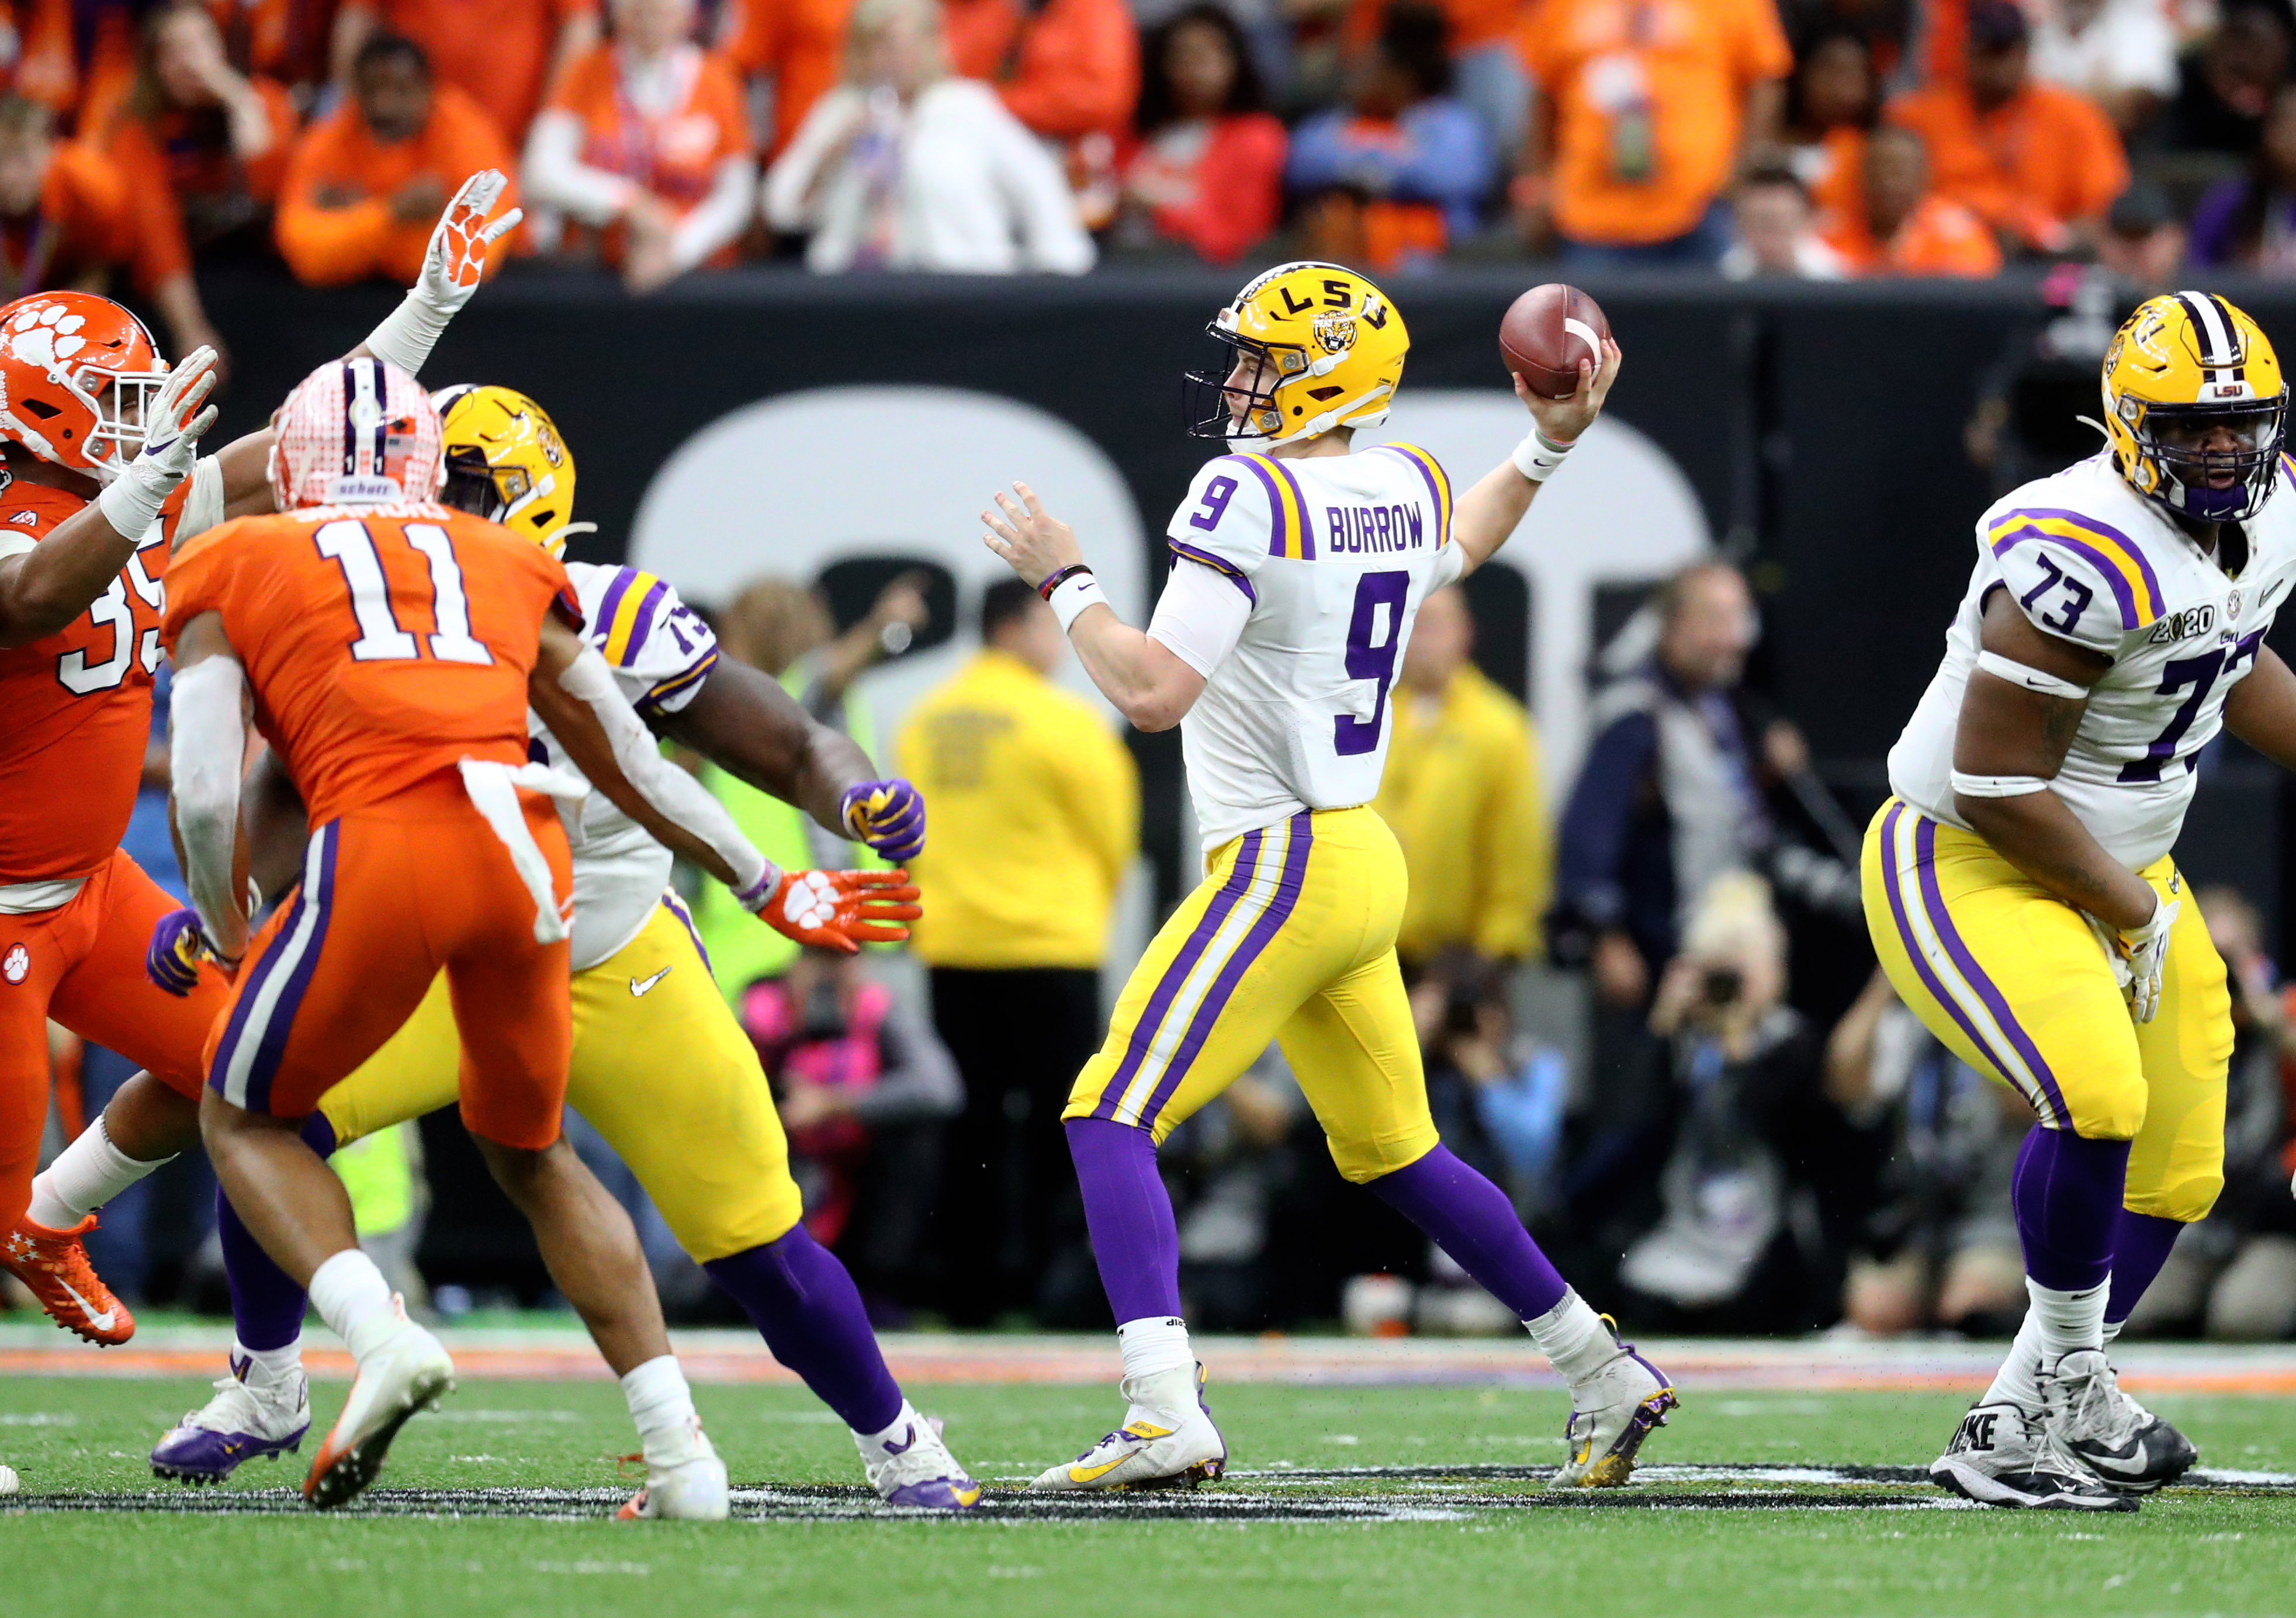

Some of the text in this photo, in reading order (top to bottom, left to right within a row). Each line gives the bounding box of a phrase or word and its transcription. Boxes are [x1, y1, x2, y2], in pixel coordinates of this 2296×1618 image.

[1280, 279, 1387, 330] LSU
[2213, 384, 2243, 399] LSU
[1190, 474, 1238, 532] 9
[1325, 501, 1423, 553] BURROW
[311, 519, 495, 666] 11
[2020, 552, 2093, 635] 73
[1333, 569, 1410, 757] 9
